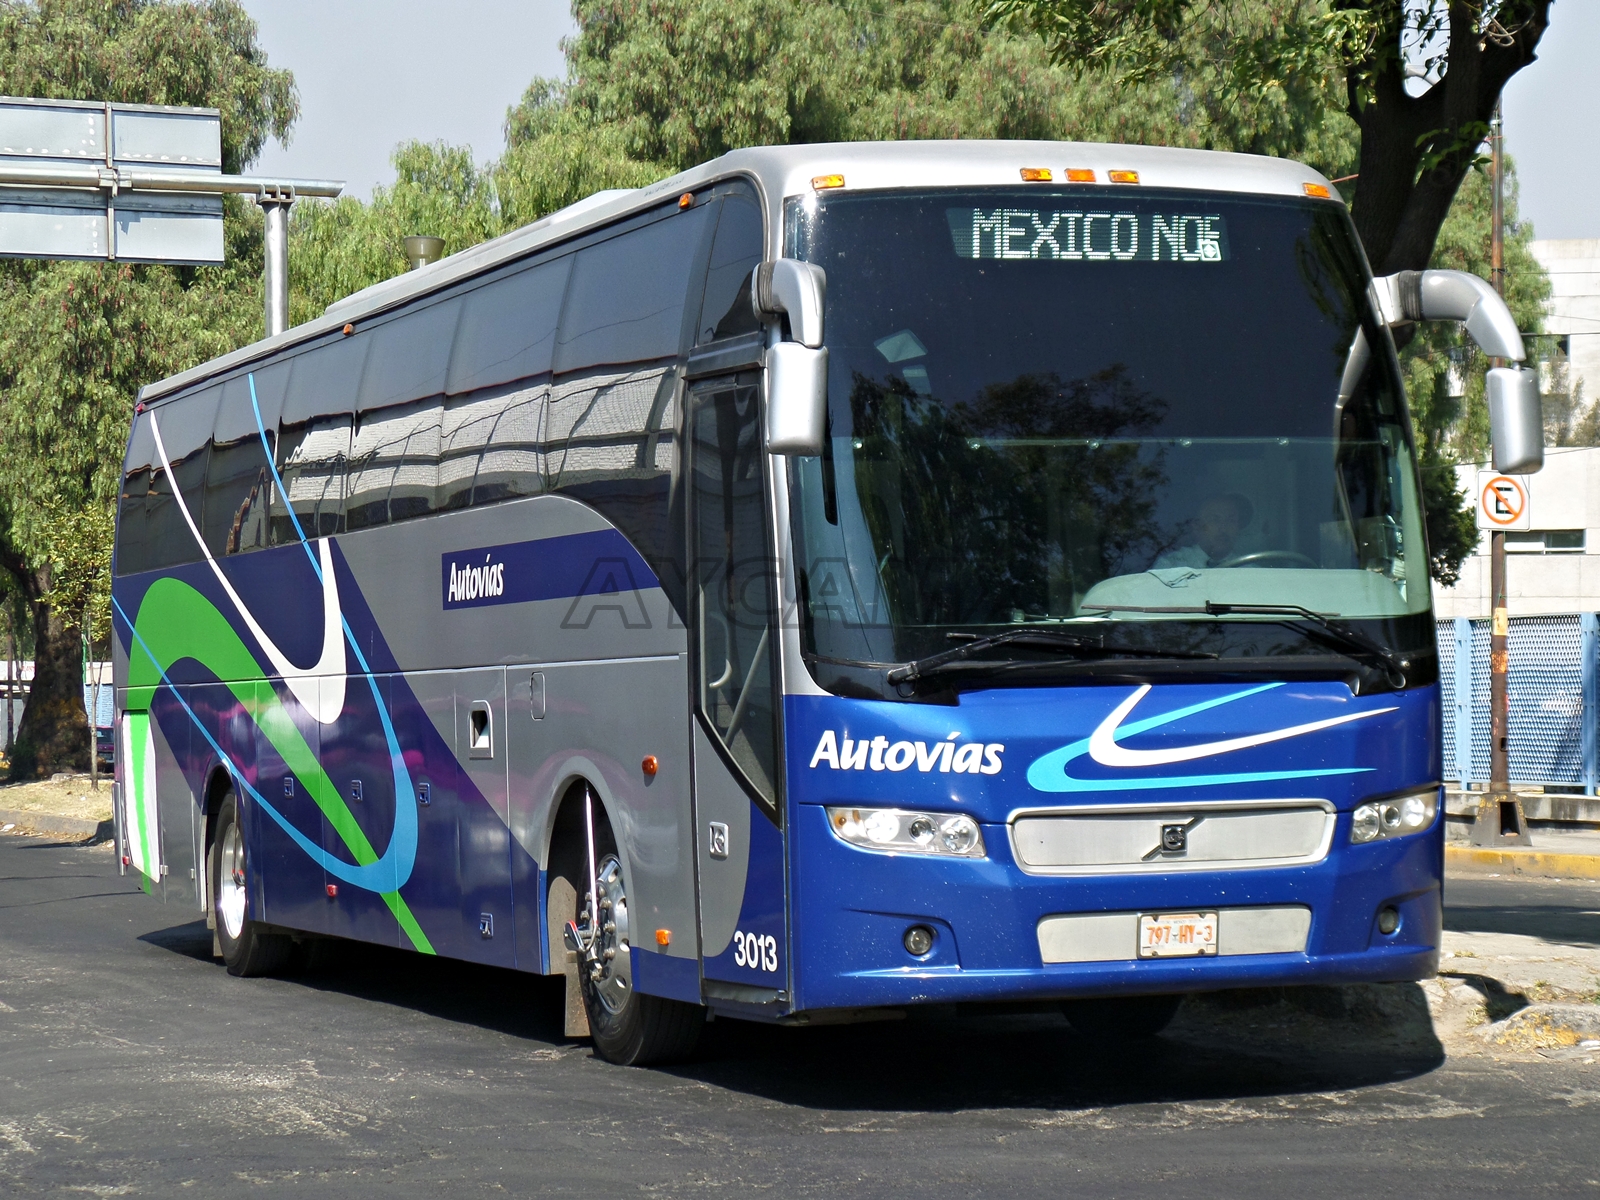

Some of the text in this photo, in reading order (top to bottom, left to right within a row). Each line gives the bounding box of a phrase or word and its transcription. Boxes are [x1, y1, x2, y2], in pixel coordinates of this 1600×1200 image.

[972, 208, 1139, 259] MEXICO
[447, 553, 504, 603] Autovías
[809, 729, 1005, 775] Autovías
[733, 930, 778, 973] 3013
